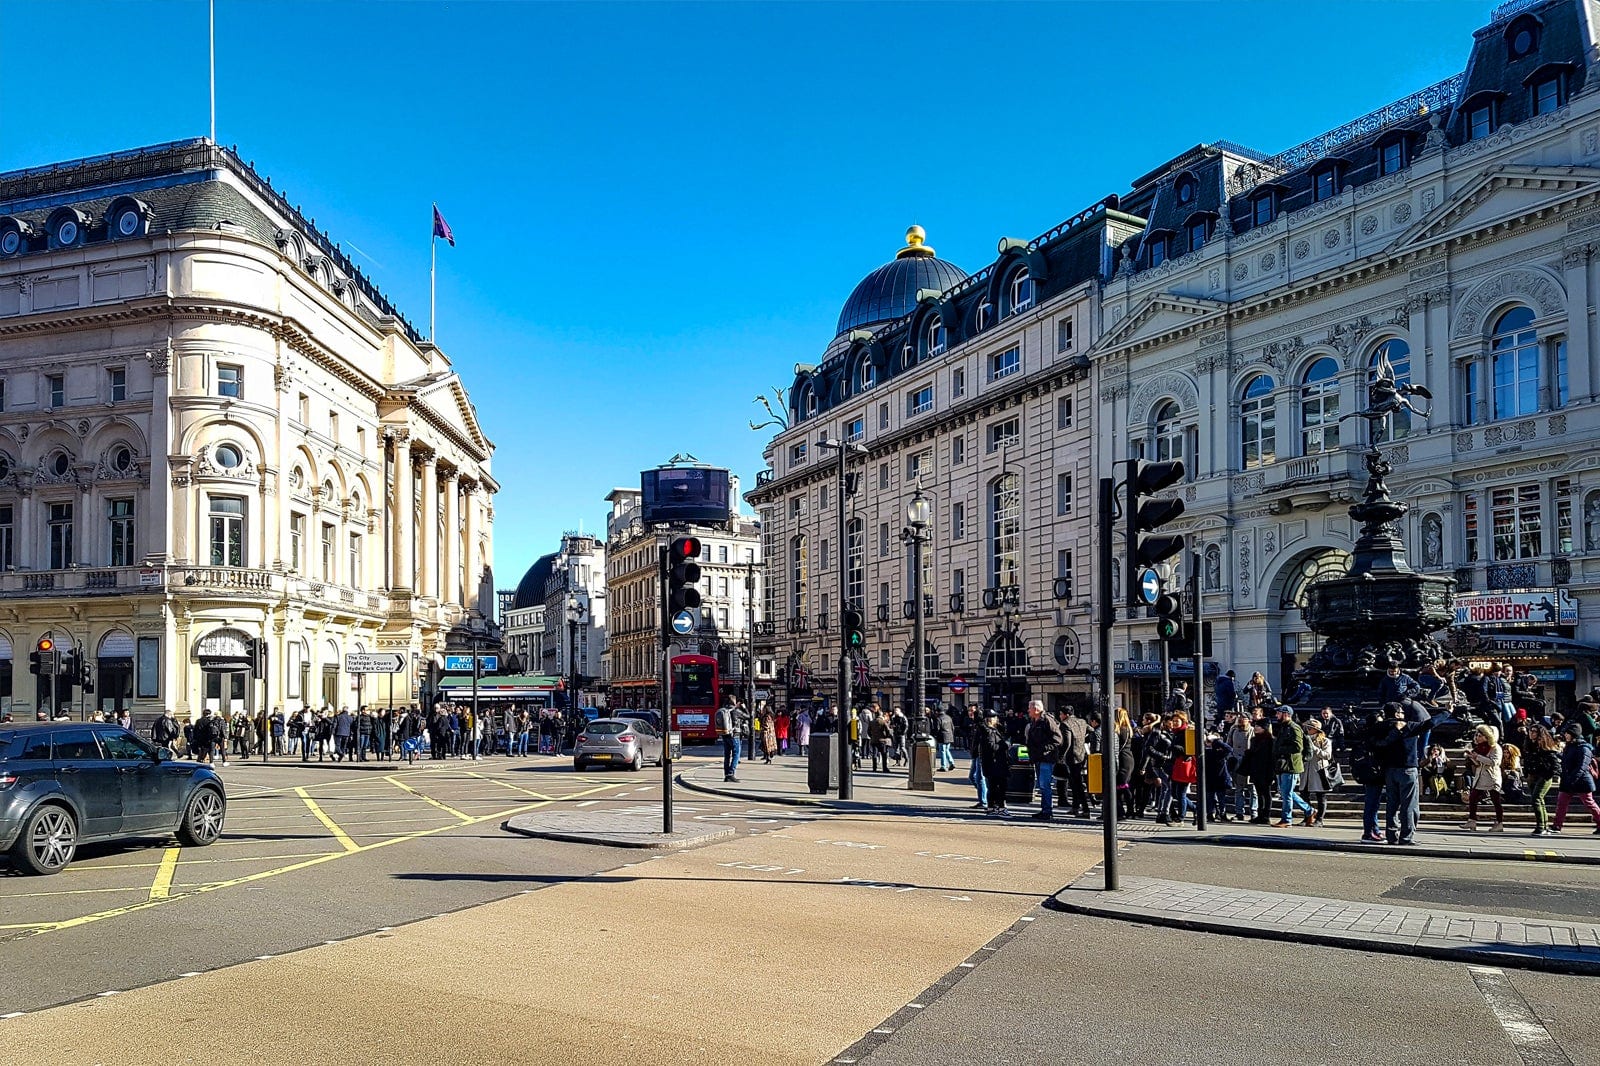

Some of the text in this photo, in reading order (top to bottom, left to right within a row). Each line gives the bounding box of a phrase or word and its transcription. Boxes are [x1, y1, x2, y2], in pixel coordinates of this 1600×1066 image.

[1455, 596, 1512, 607] THE COMEDY ABOUT A
[1470, 603, 1531, 622] ROBBERY
[1560, 611, 1577, 619] BANK
[1495, 640, 1542, 649] THEATRE
